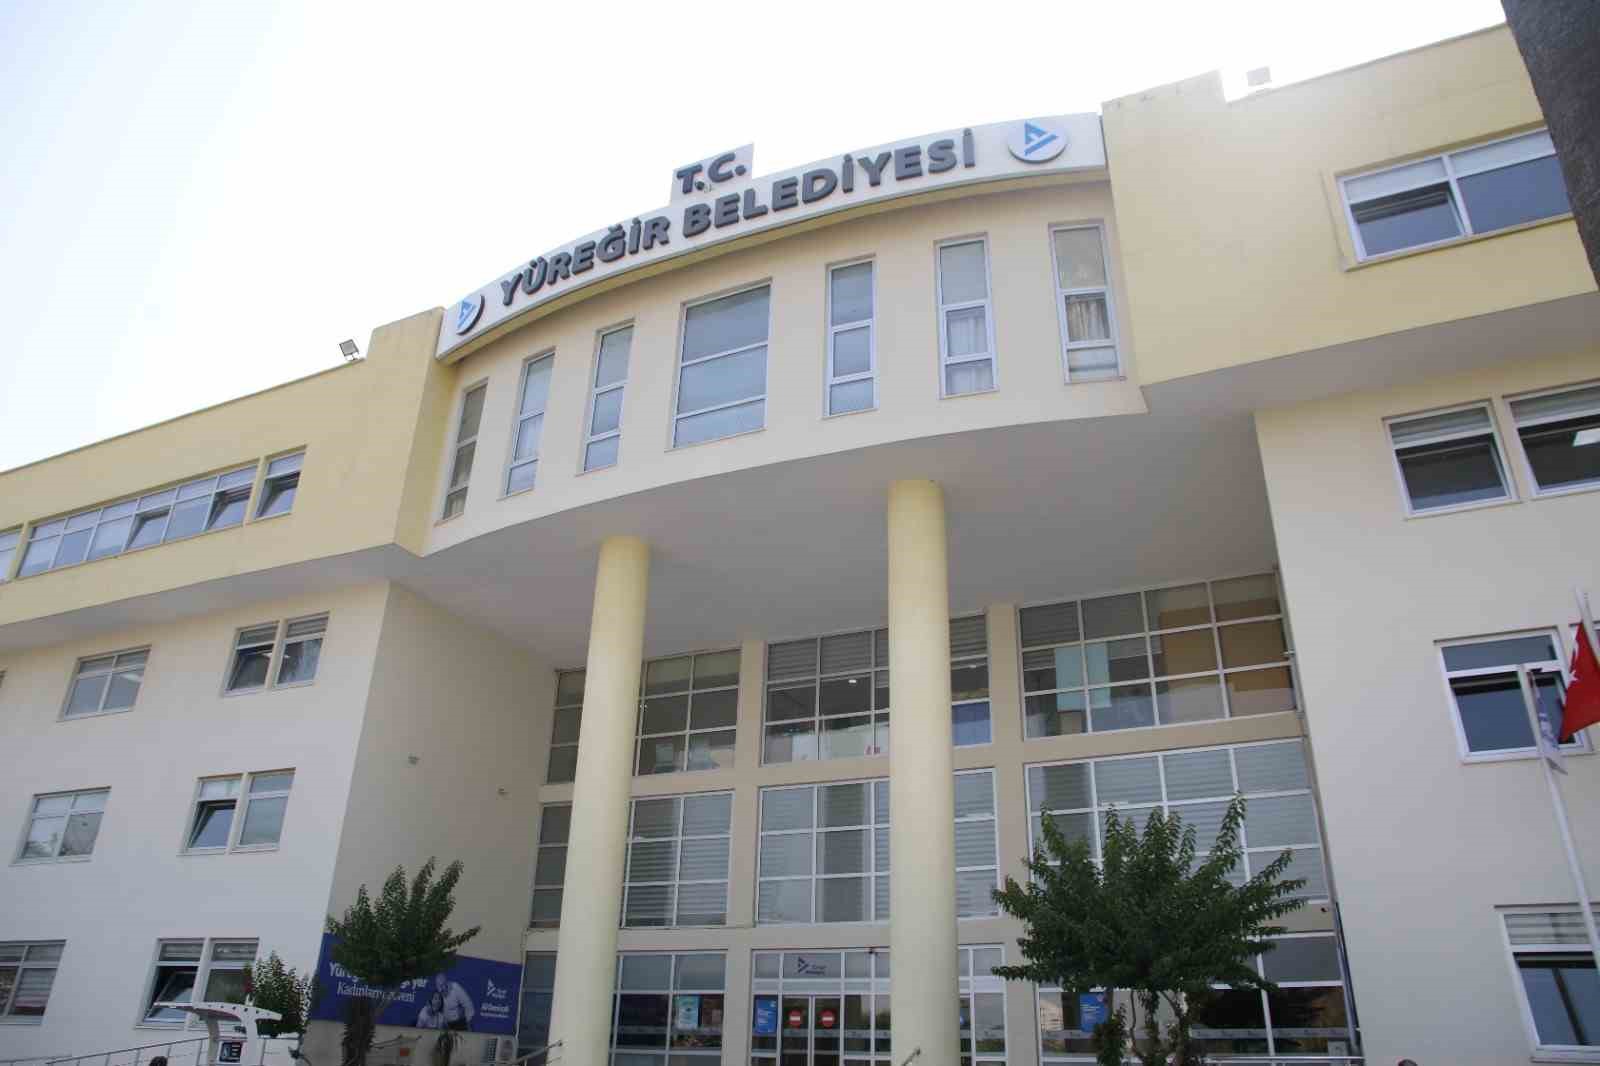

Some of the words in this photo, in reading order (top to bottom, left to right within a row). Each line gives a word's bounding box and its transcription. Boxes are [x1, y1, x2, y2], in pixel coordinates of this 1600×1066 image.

[500, 216, 671, 306] YÜREĞİR
[682, 128, 976, 238] BELEDİYESİ
[676, 152, 747, 194] T.C.
